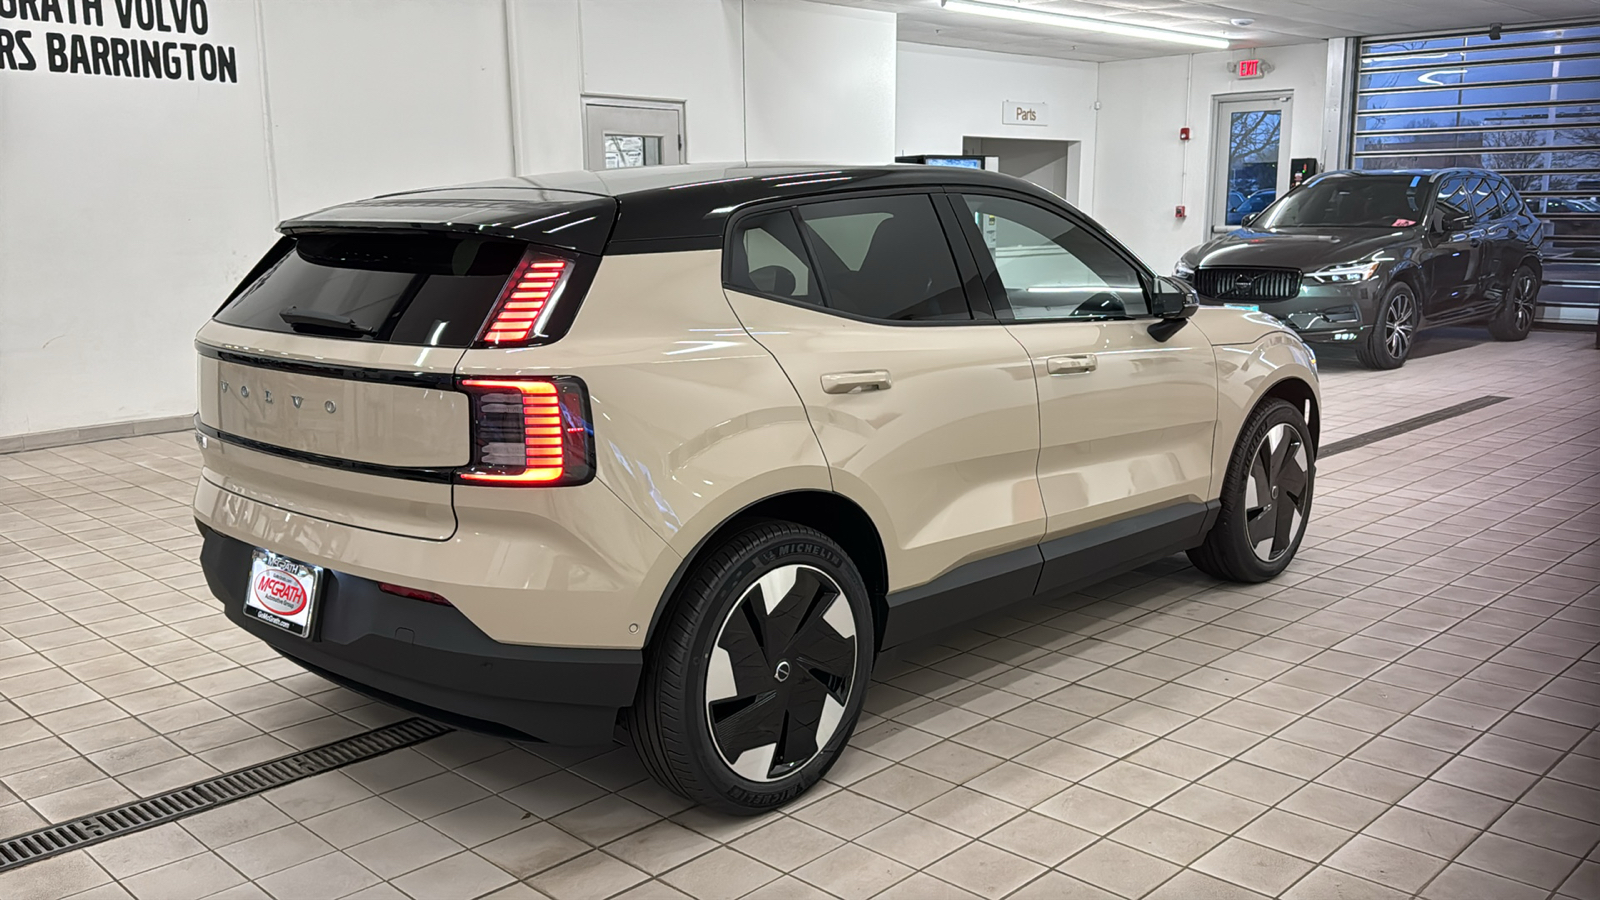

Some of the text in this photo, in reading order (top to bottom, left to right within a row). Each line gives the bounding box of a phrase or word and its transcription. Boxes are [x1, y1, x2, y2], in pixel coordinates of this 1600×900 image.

[114, 0, 209, 35] VOLVO
[0, 28, 238, 83] RS BARRINGTON
[1239, 59, 1259, 76] EXIT
[1016, 107, 1037, 121] Parts
[220, 380, 337, 414] VOLVO
[779, 543, 841, 566] MICHELIN
